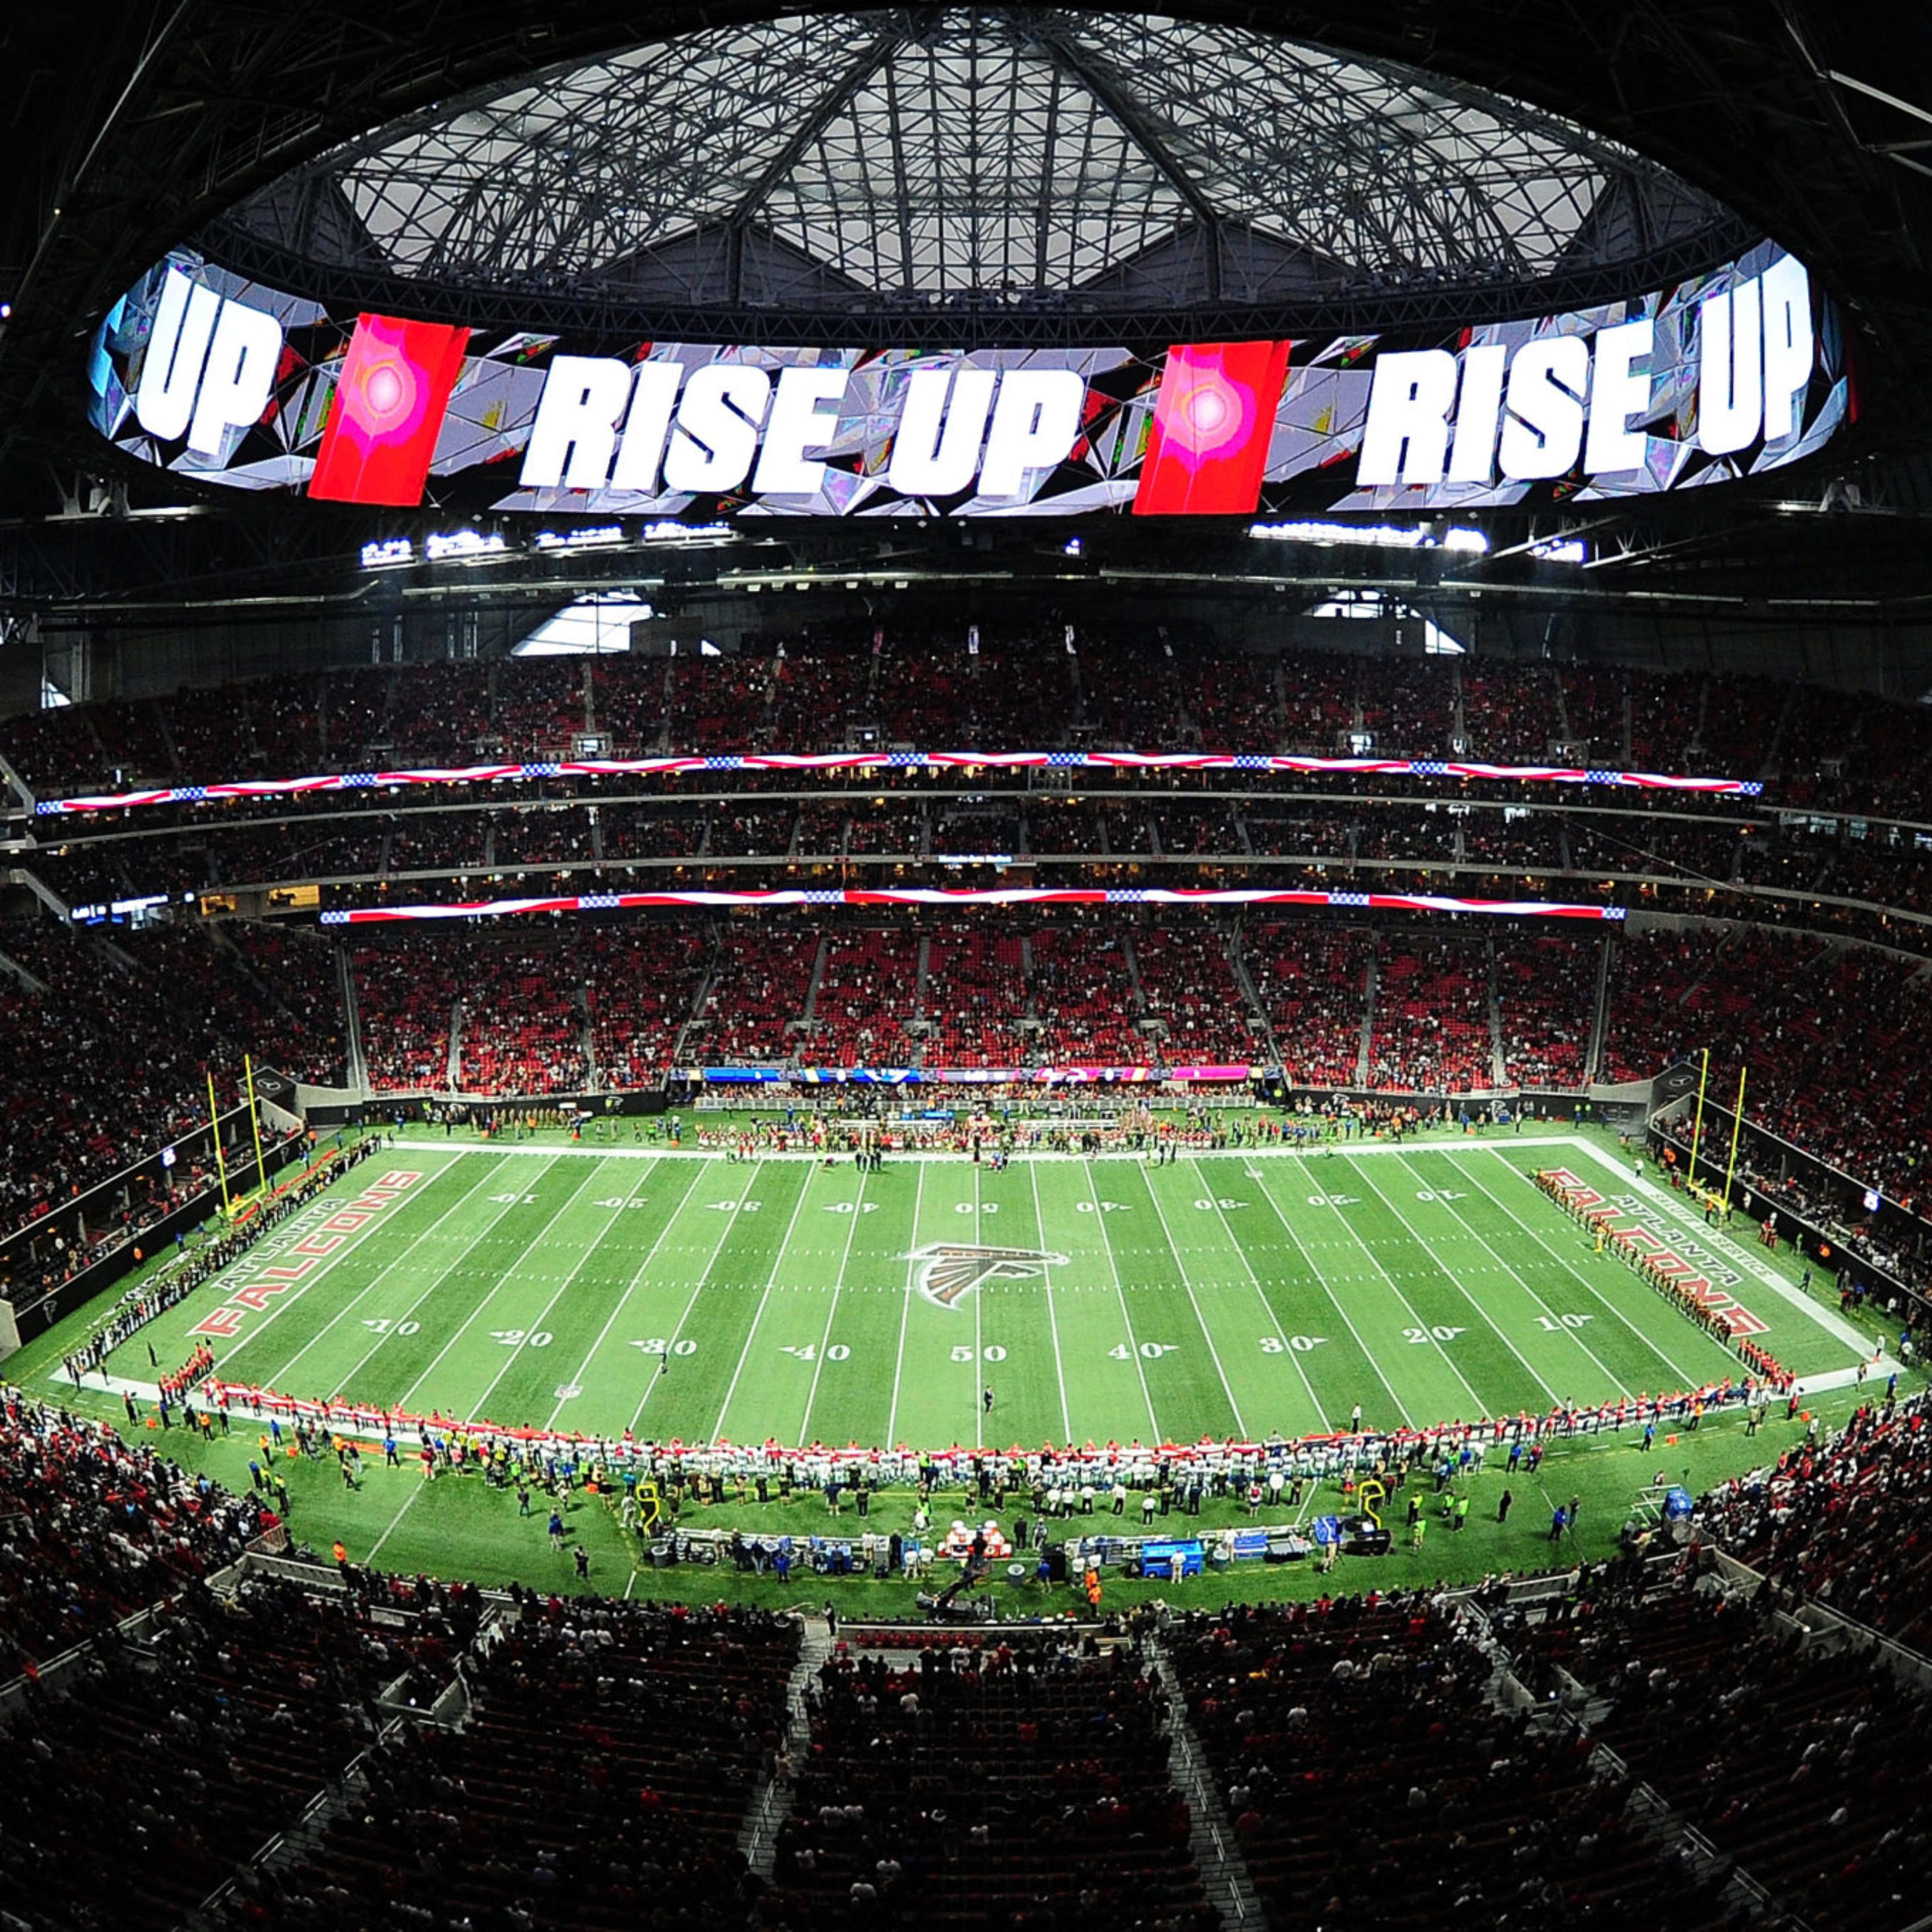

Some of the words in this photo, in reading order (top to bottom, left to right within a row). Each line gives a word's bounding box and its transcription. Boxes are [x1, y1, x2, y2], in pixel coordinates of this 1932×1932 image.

[136, 267, 283, 456] UP
[1355, 318, 1654, 485] RISE
[1698, 252, 1813, 455] UP
[519, 354, 850, 494] RISE
[890, 369, 1085, 496] UP
[211, 1198, 347, 1291] ATLANTA
[1609, 1193, 1743, 1286] ATLANTA
[184, 1170, 425, 1338] FALCONS
[369, 1319, 421, 1336] 10
[1533, 1314, 1583, 1331] 10
[498, 1329, 553, 1347] 20
[1402, 1326, 1455, 1344] 20
[641, 1338, 697, 1355] 30
[794, 1344, 850, 1360] 40
[950, 1345, 1006, 1361] 50
[1108, 1342, 1163, 1360] 40
[1259, 1336, 1314, 1353] 30
